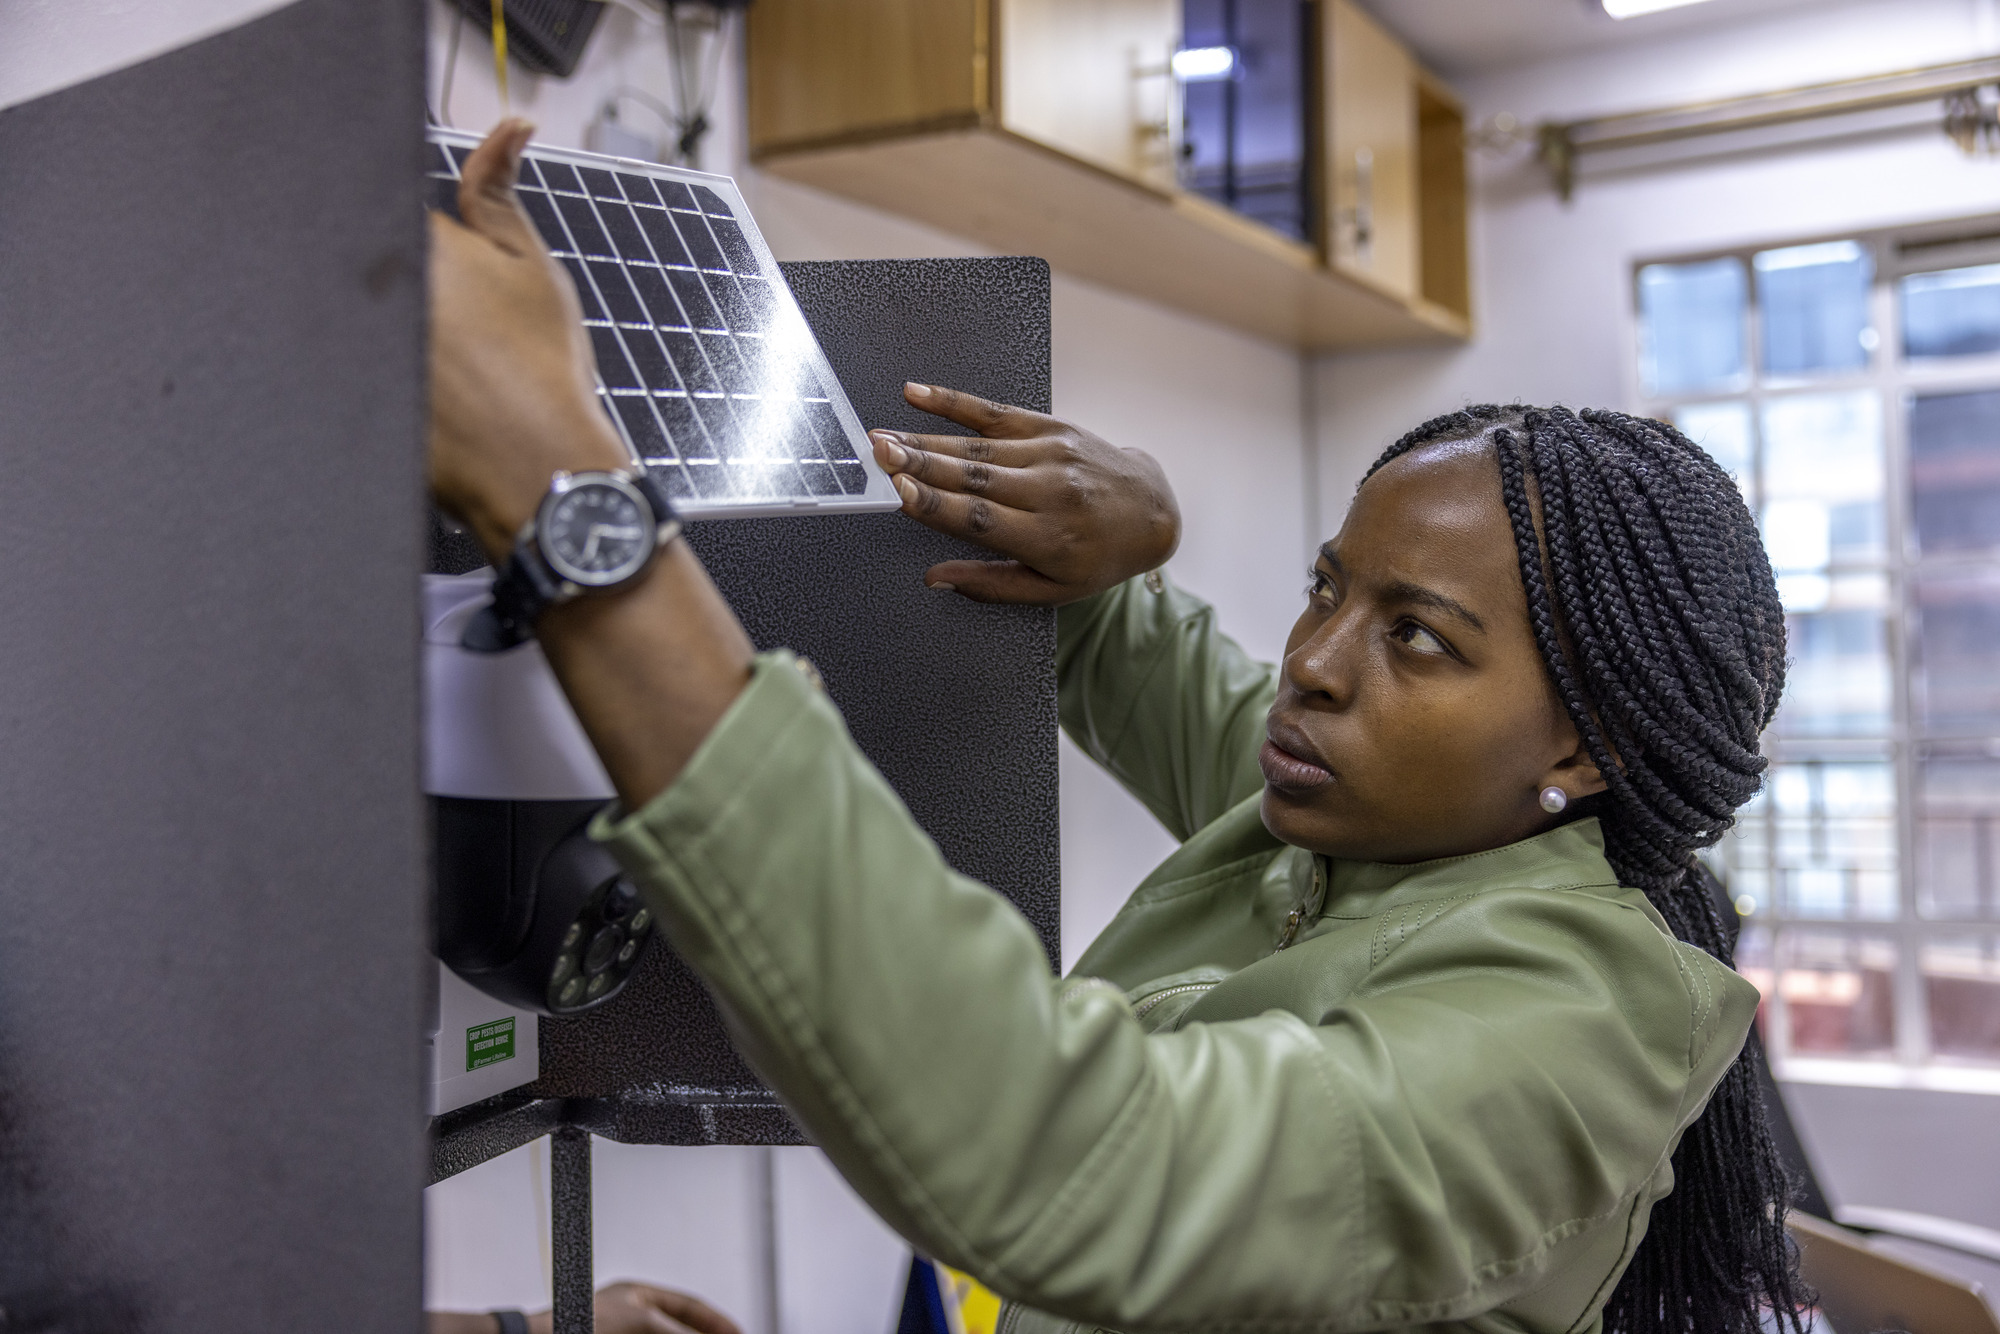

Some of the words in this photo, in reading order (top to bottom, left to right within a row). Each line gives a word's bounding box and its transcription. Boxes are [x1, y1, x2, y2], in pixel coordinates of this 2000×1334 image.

[469, 1030, 480, 1041] CROP
[474, 1038, 494, 1052] DETECTION
[495, 1034, 508, 1045] DEVICE
